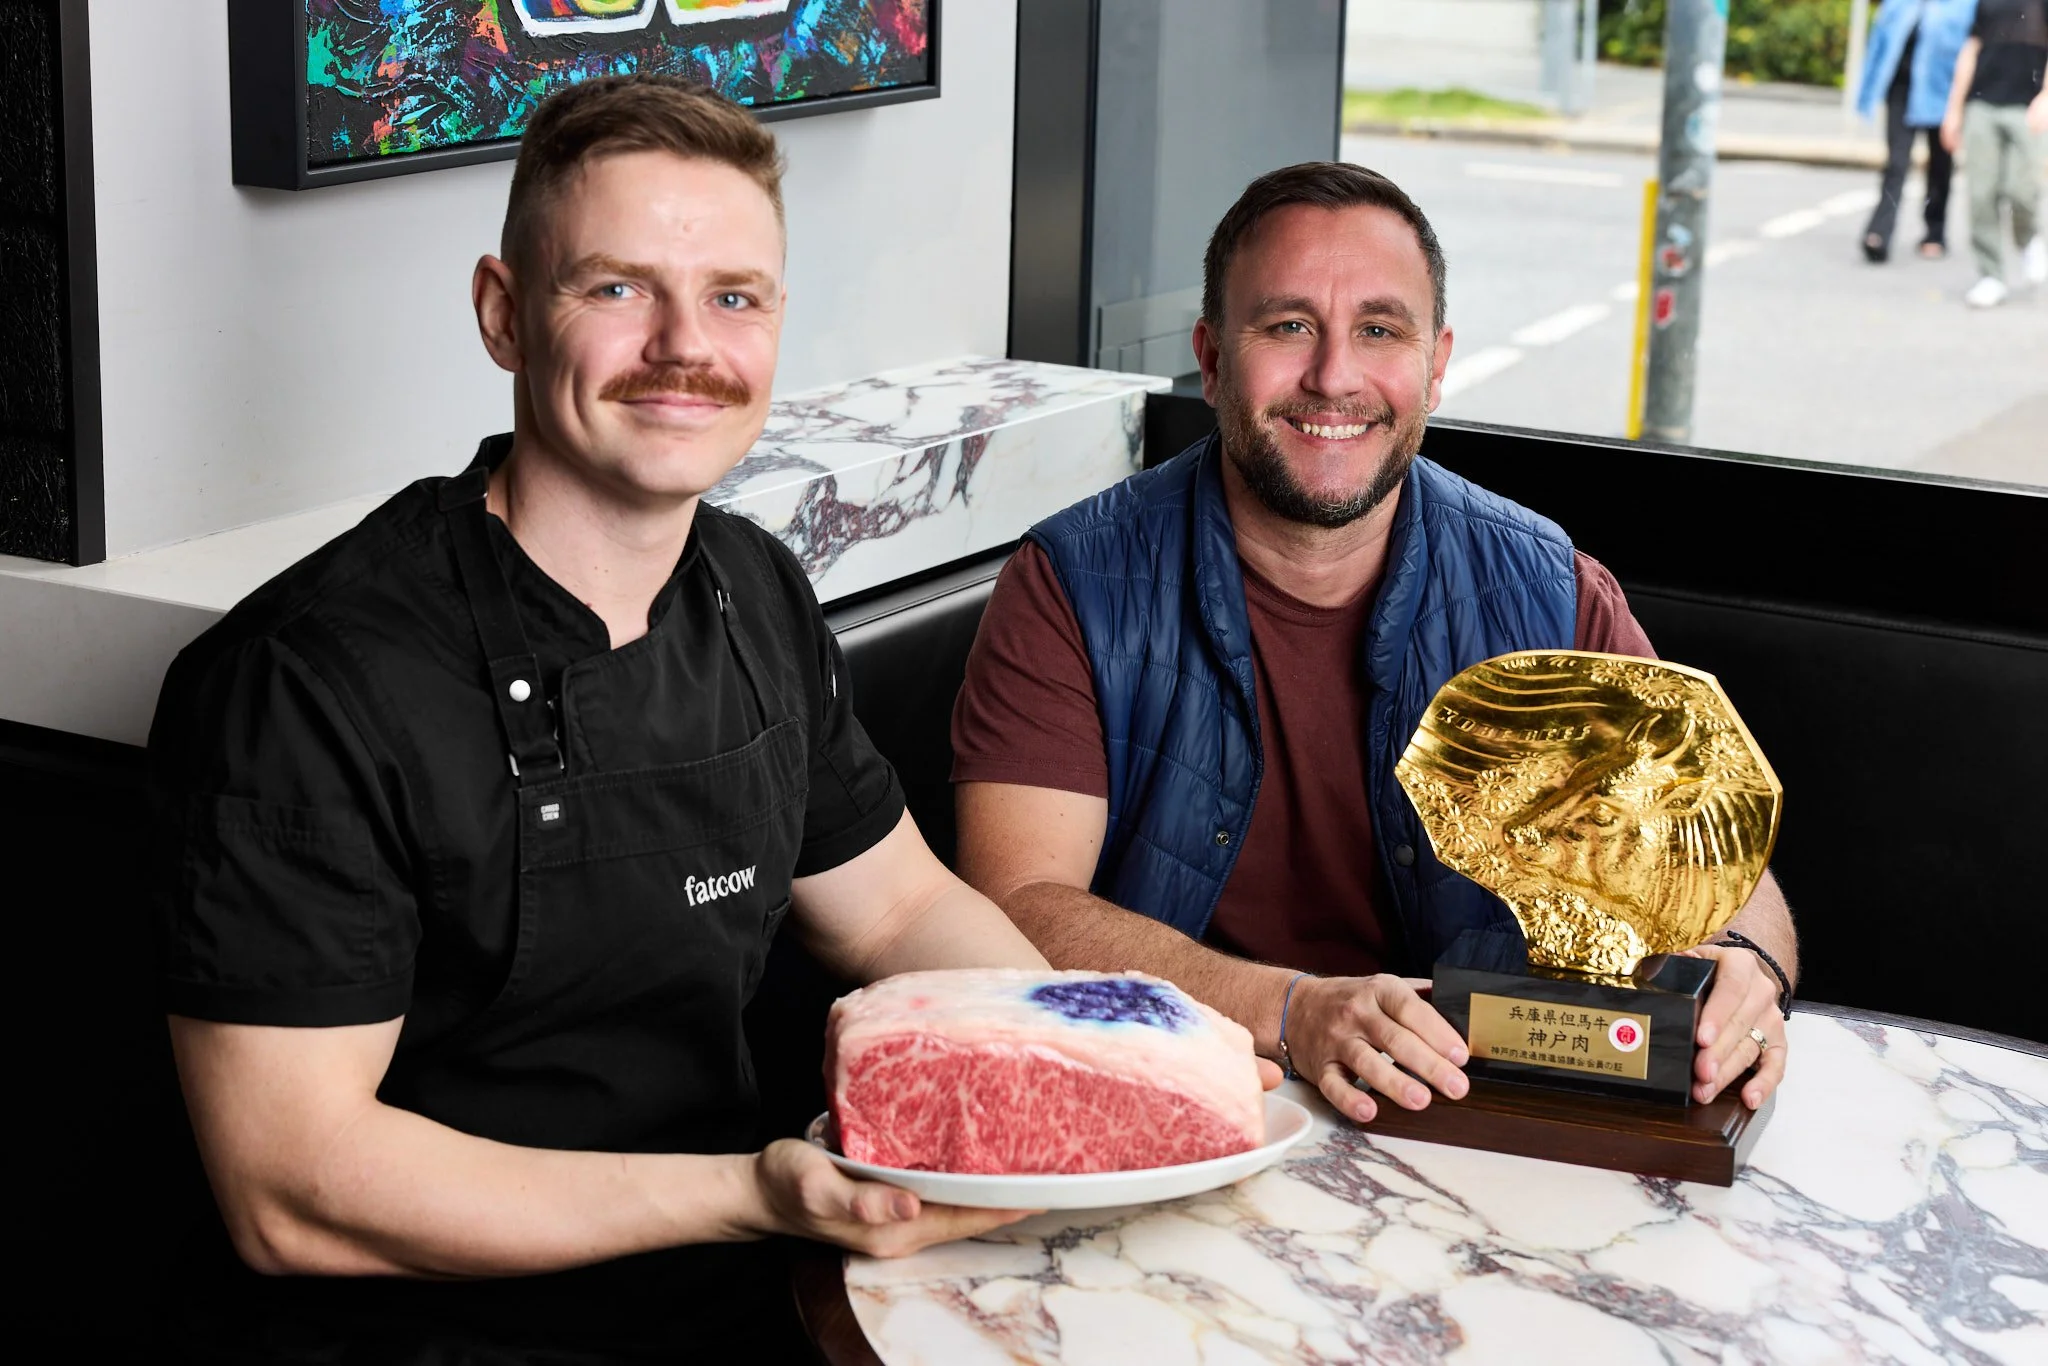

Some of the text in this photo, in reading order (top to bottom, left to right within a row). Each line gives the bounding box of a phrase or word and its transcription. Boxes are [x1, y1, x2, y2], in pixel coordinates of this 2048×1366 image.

[684, 865, 756, 907] fatcow
[1509, 1006, 1609, 1032] 兵庫県但馬牛
